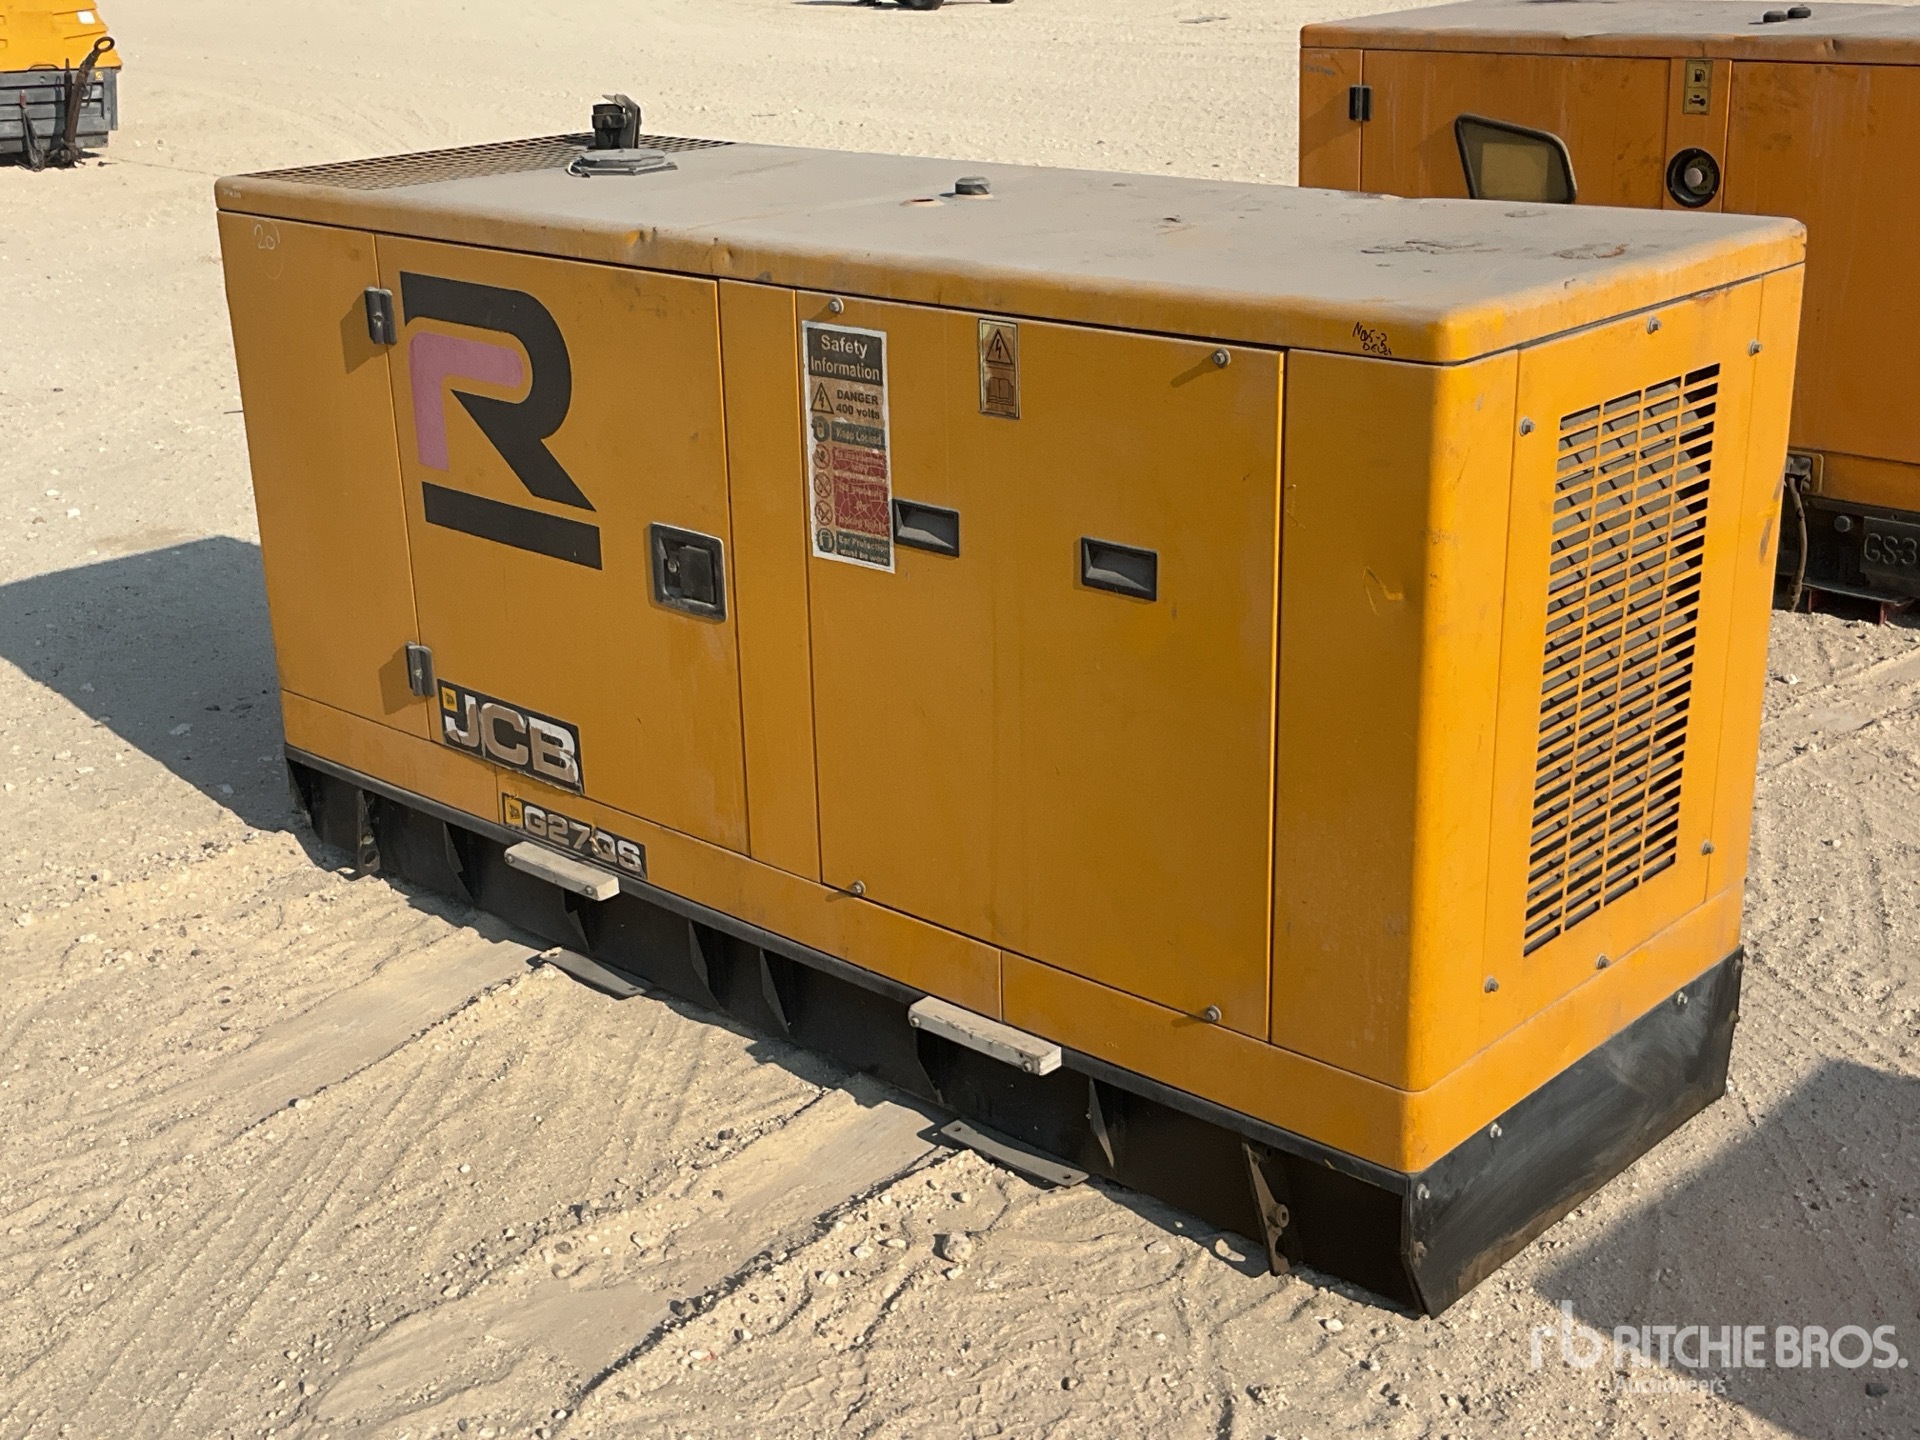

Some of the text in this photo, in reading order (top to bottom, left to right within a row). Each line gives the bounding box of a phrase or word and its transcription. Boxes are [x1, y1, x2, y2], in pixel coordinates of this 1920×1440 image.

[821, 334, 868, 359] Safety
[810, 355, 881, 381] Information
[836, 389, 879, 406] DANGER
[836, 403, 880, 420] 400 volts
[444, 694, 579, 784] JCB
